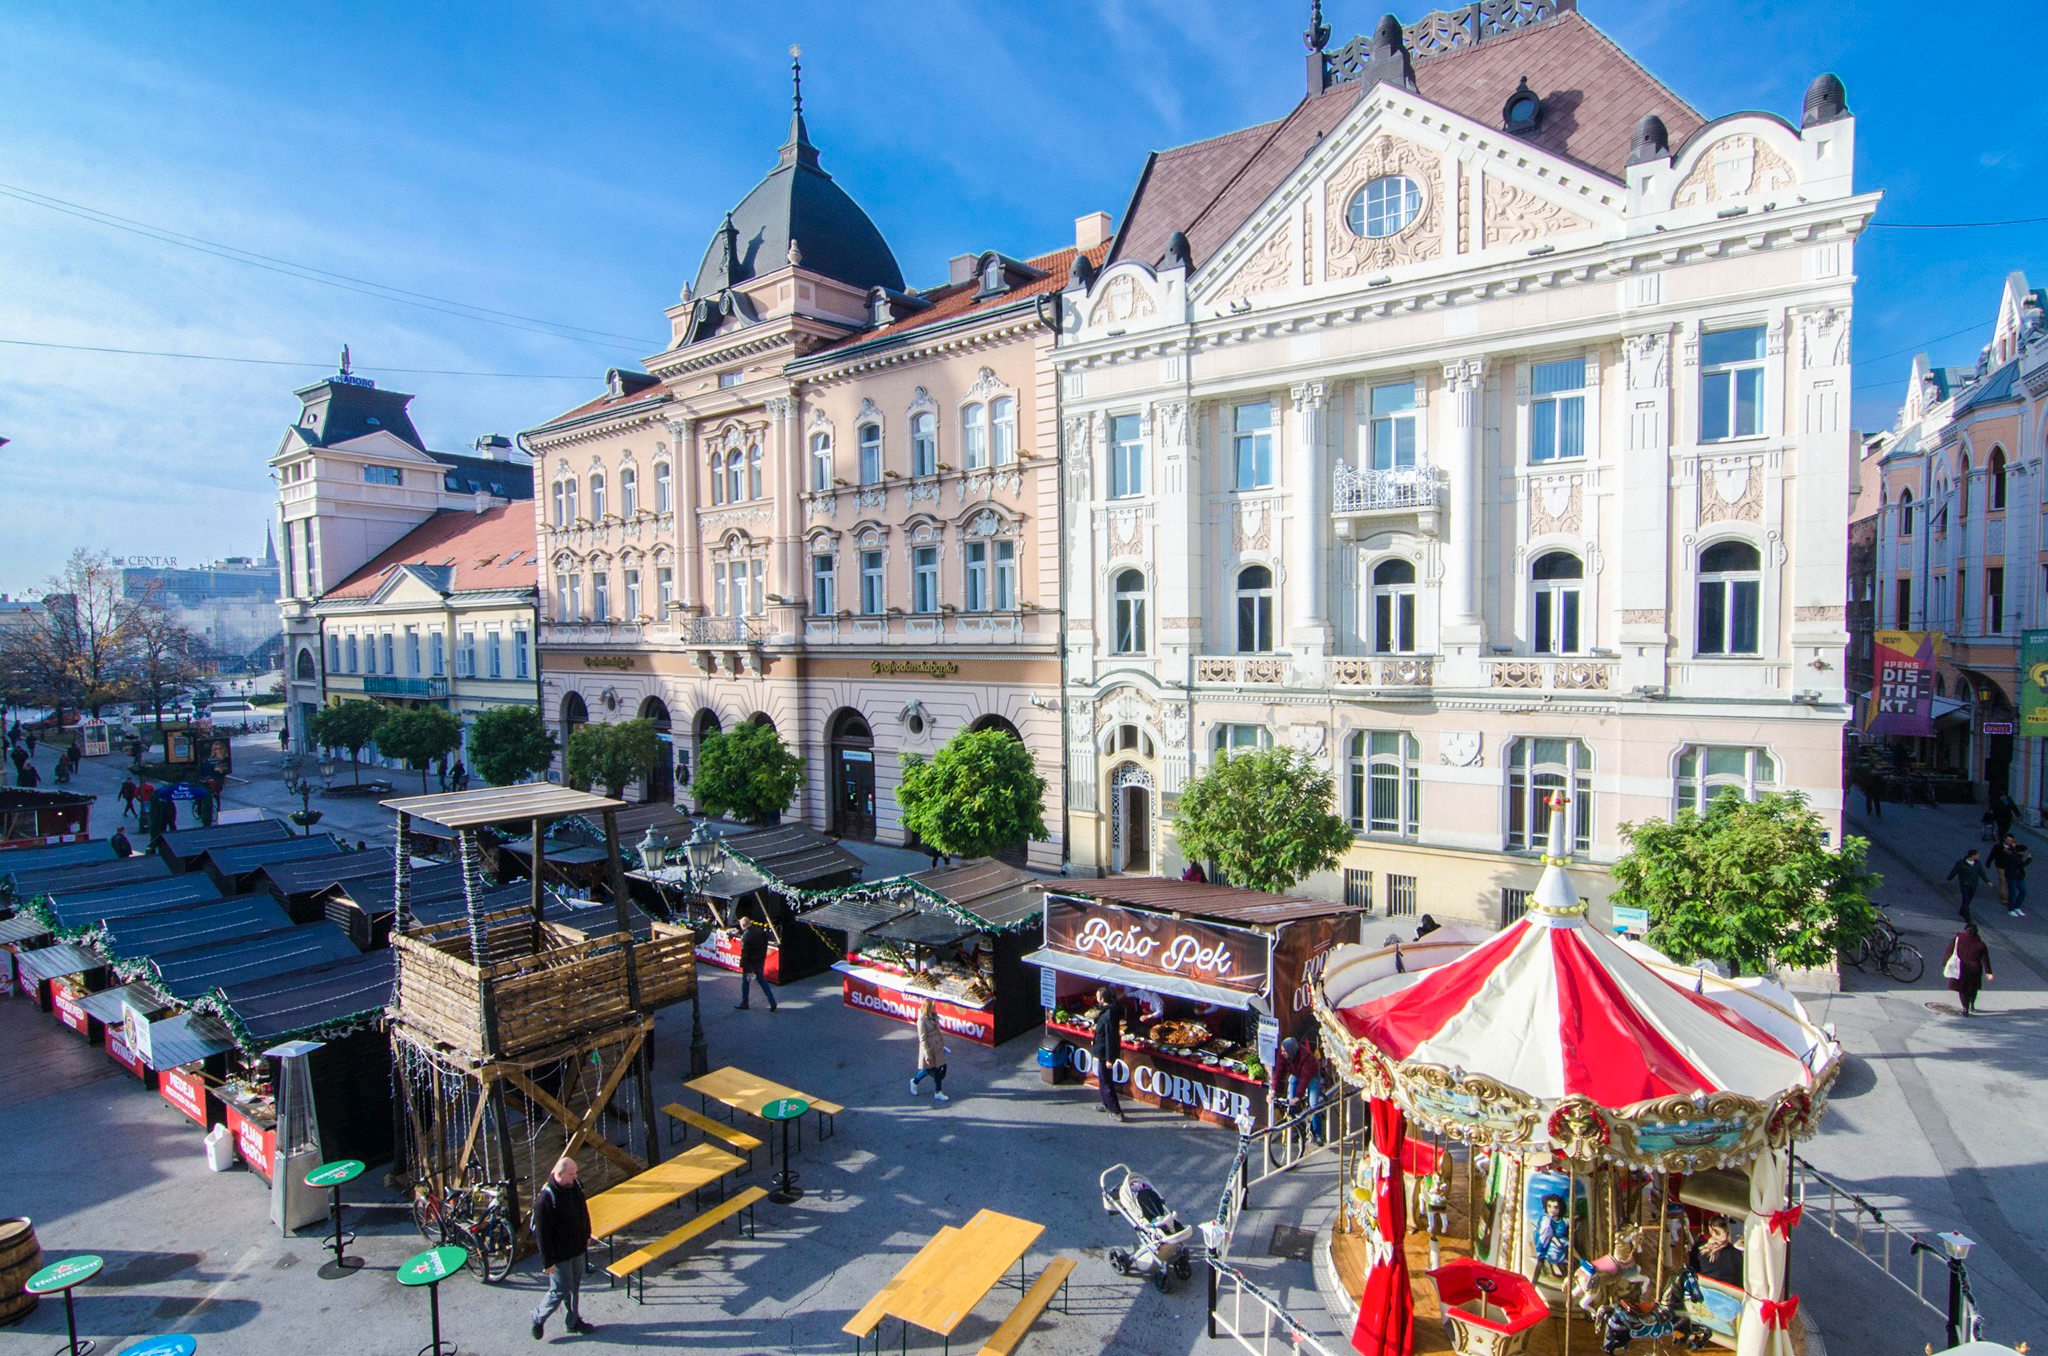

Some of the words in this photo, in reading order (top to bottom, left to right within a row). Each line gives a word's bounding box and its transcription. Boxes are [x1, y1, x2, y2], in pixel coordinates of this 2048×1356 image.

[128, 555, 178, 566] CENTAR
[1075, 917, 1160, 959] Rašo
[1161, 934, 1232, 974] Pek
[851, 991, 916, 1019] SLOBODAN
[1134, 1065, 1251, 1119] CORNER
[33, 1259, 98, 1288] Heineken
